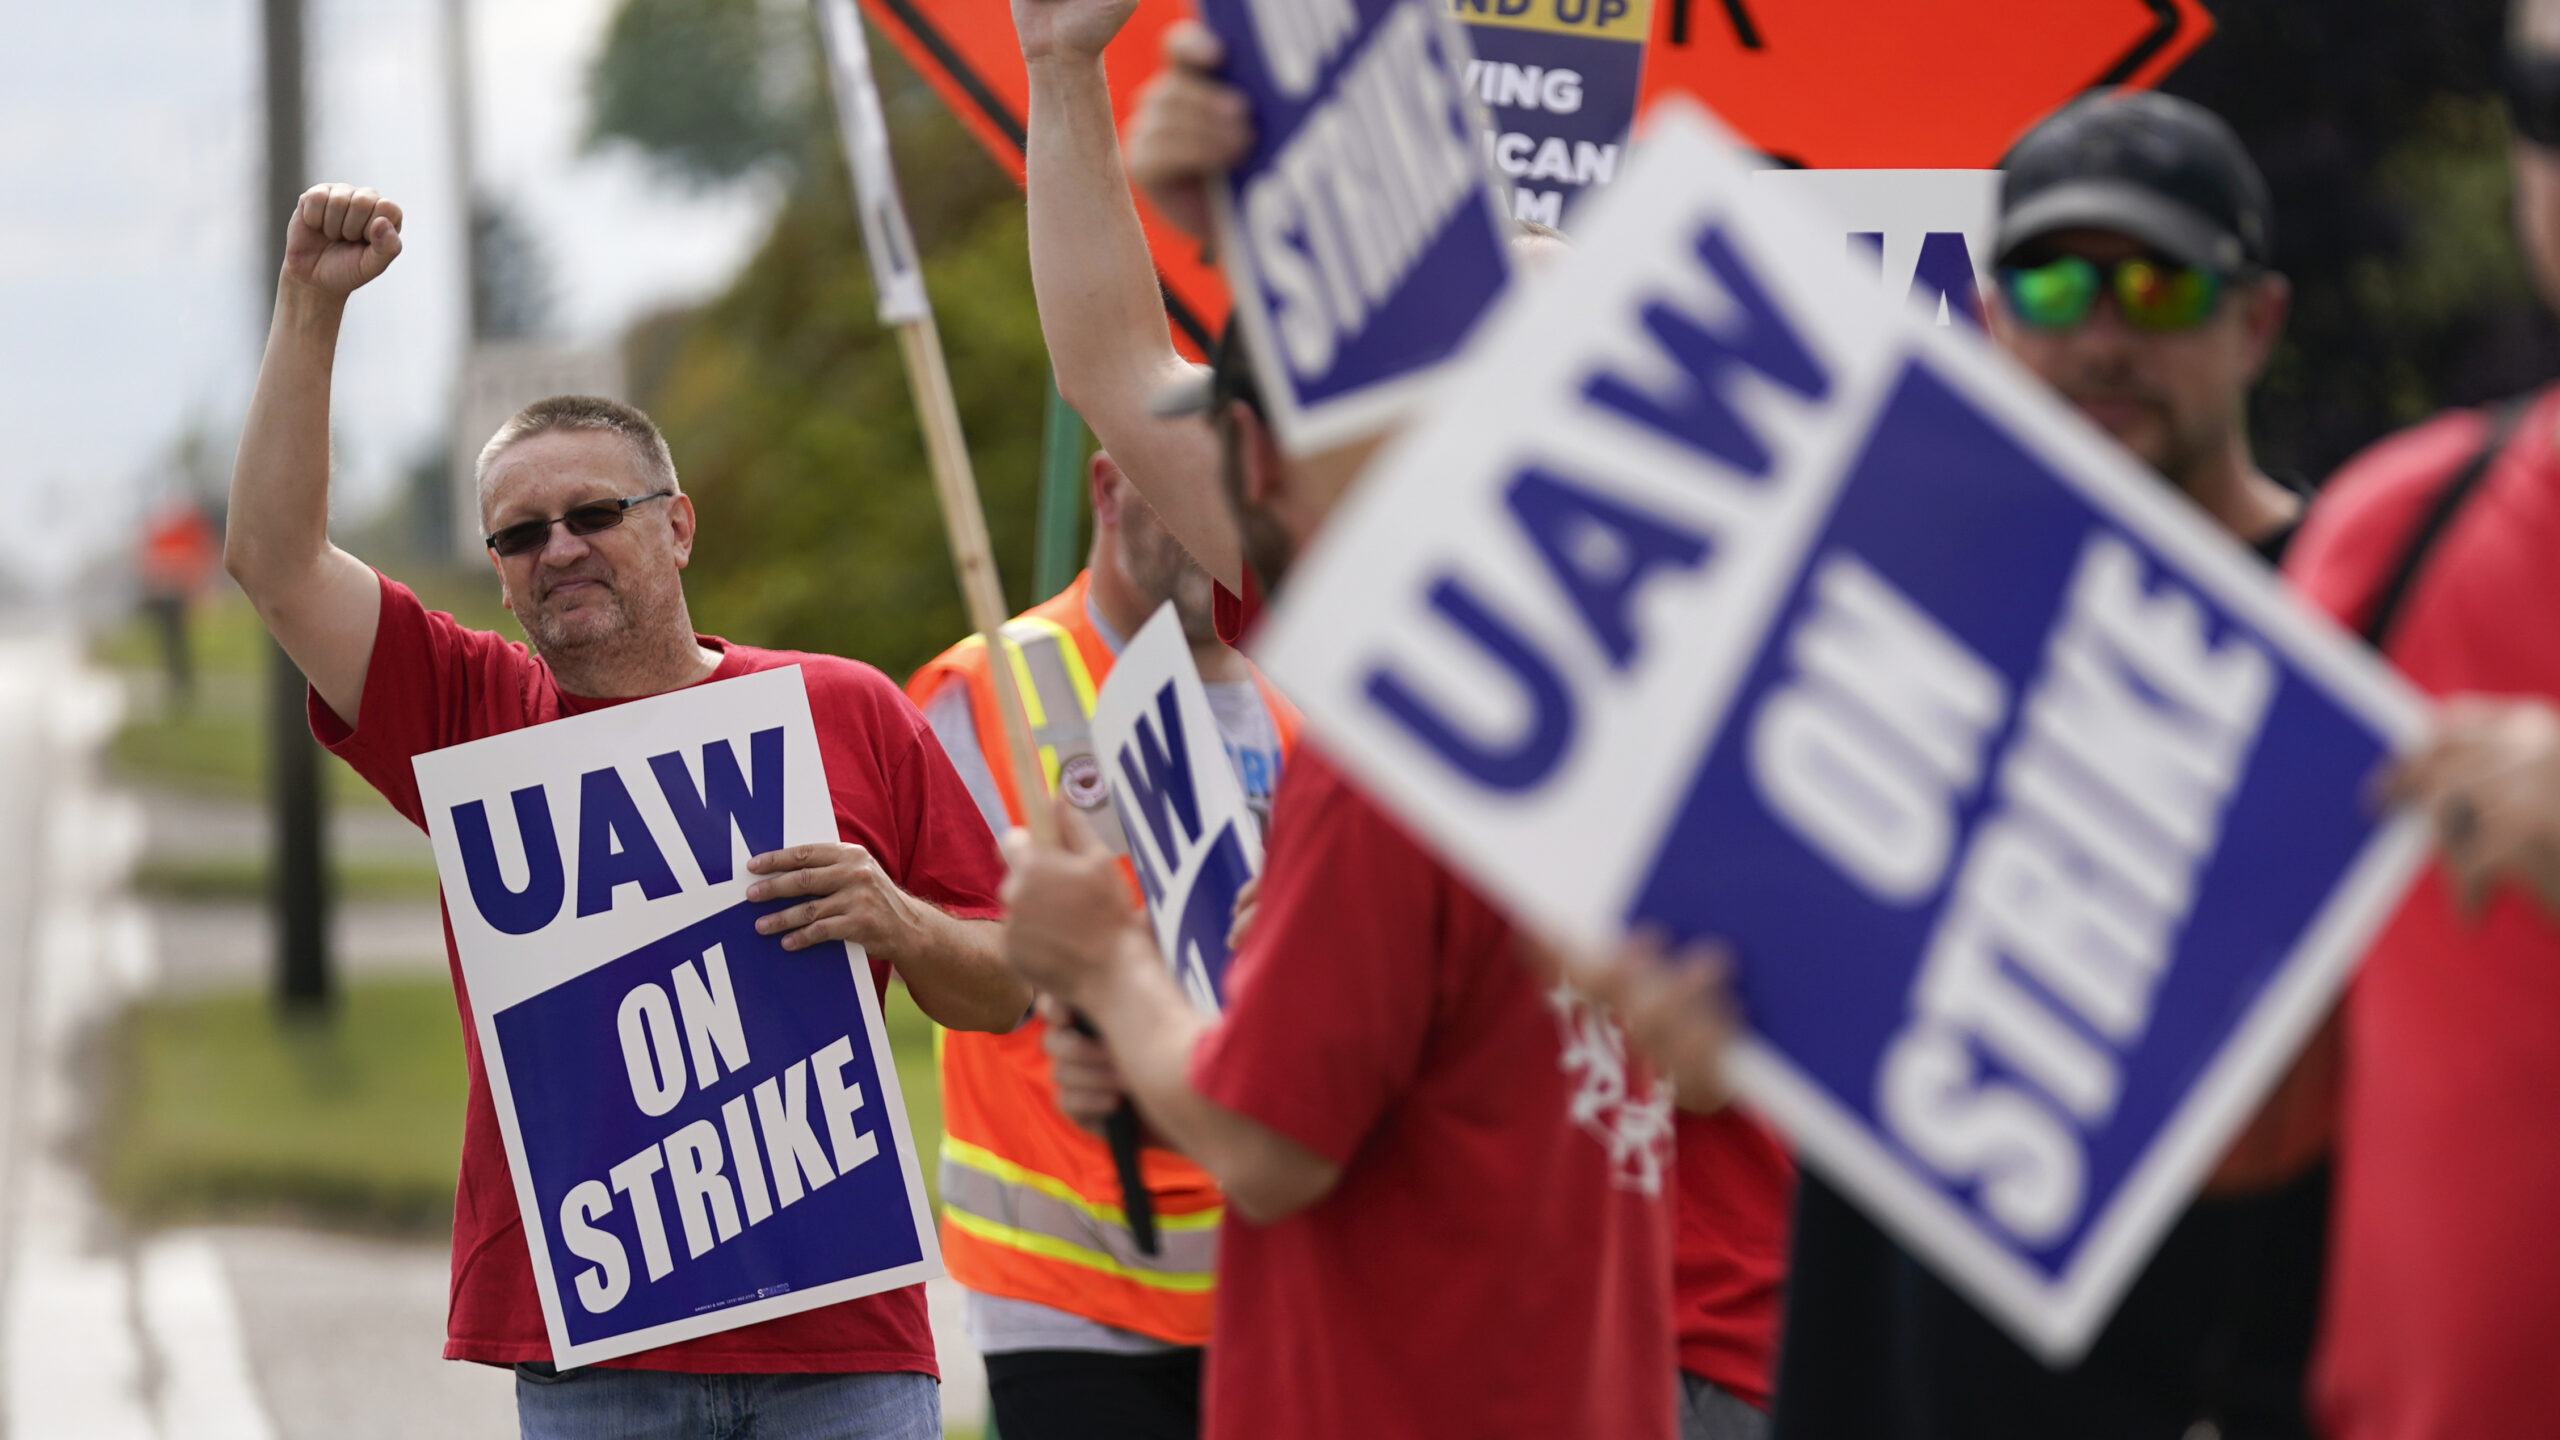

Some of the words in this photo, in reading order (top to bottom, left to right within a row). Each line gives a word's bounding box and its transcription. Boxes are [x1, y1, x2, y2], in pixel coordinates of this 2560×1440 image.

[1360, 220, 1837, 798] UAW
[450, 726, 785, 935] UAW
[1748, 552, 2006, 906] ON
[1876, 530, 2276, 1243] STRIKE
[559, 1034, 879, 1314] STRIKE
[616, 942, 751, 1117] ON
